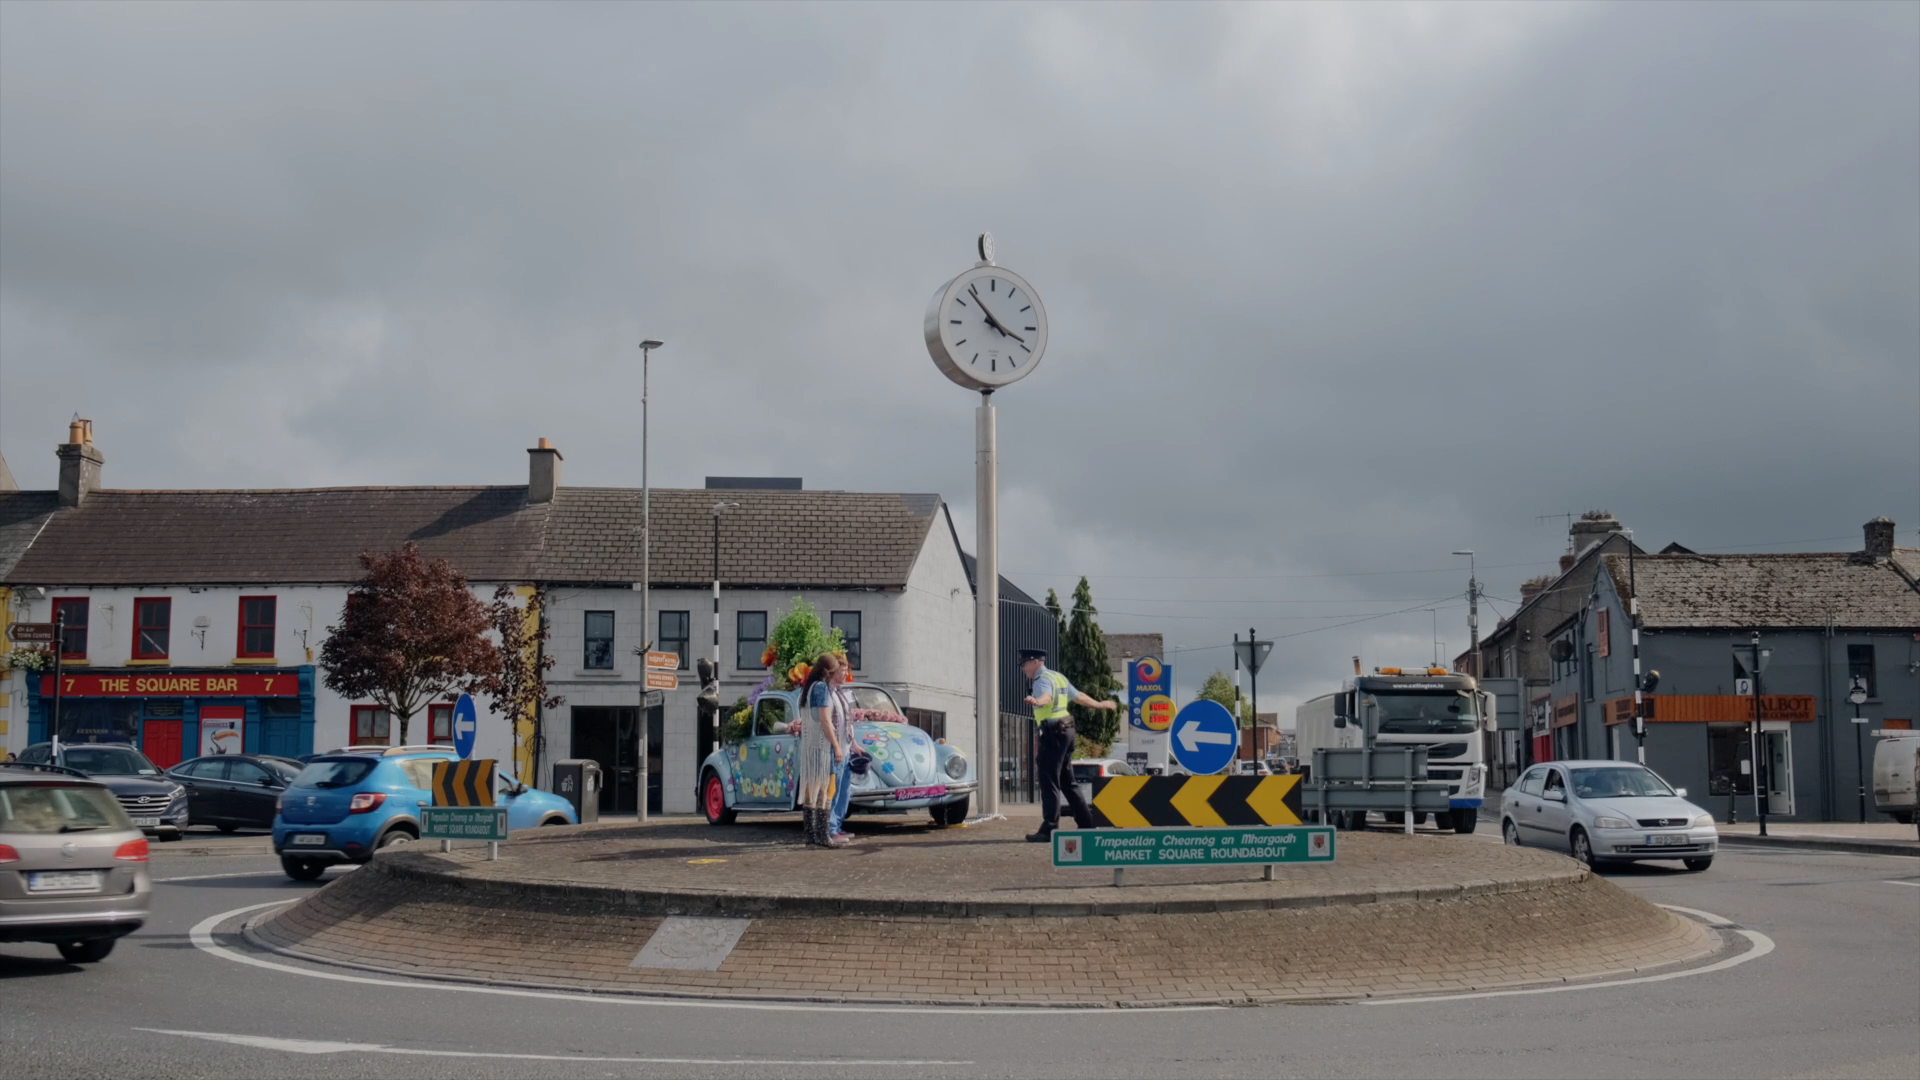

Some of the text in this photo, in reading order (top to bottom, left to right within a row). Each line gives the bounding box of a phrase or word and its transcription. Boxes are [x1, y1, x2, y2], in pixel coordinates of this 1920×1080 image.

[65, 679, 75, 692] 7
[99, 678, 238, 692] THE SQUARE BAR
[264, 678, 274, 691] 7
[1221, 836, 1235, 845] an
[1104, 847, 1287, 861] MARKET SQUARE ROUNDABOUT
